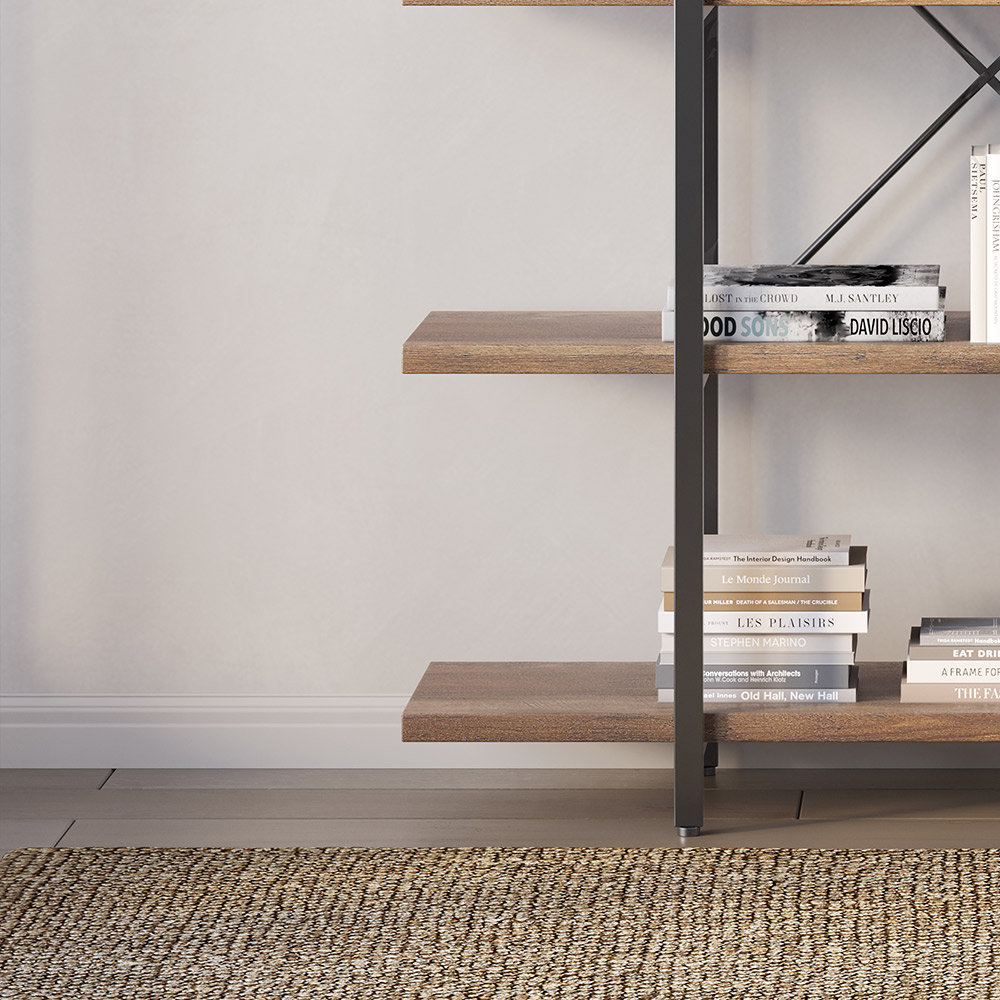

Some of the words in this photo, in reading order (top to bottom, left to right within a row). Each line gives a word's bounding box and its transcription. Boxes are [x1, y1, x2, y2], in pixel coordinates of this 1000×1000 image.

[705, 294, 733, 303] LOST
[759, 294, 798, 303] CROWD
[826, 294, 845, 303] M.J.
[848, 294, 899, 303] SANTLEY
[741, 316, 789, 337] SONS
[850, 318, 889, 336] DAVID
[892, 318, 932, 336] LISCIO
[772, 555, 794, 563] Design
[721, 575, 733, 584] Le
[736, 575, 771, 584] Monde
[773, 575, 810, 585] Journal
[737, 618, 762, 628] LES
[769, 618, 835, 628] PLAISIRS
[710, 638, 760, 648] STEPHEN
[763, 638, 807, 648] MARINO
[953, 649, 974, 658] EAT
[941, 667, 948, 677] A
[950, 667, 982, 677] FRAME
[740, 691, 760, 700] Old
[763, 691, 787, 701] Hall,
[790, 691, 814, 700] New
[818, 691, 839, 700] Hall
[954, 687, 981, 699] THE
